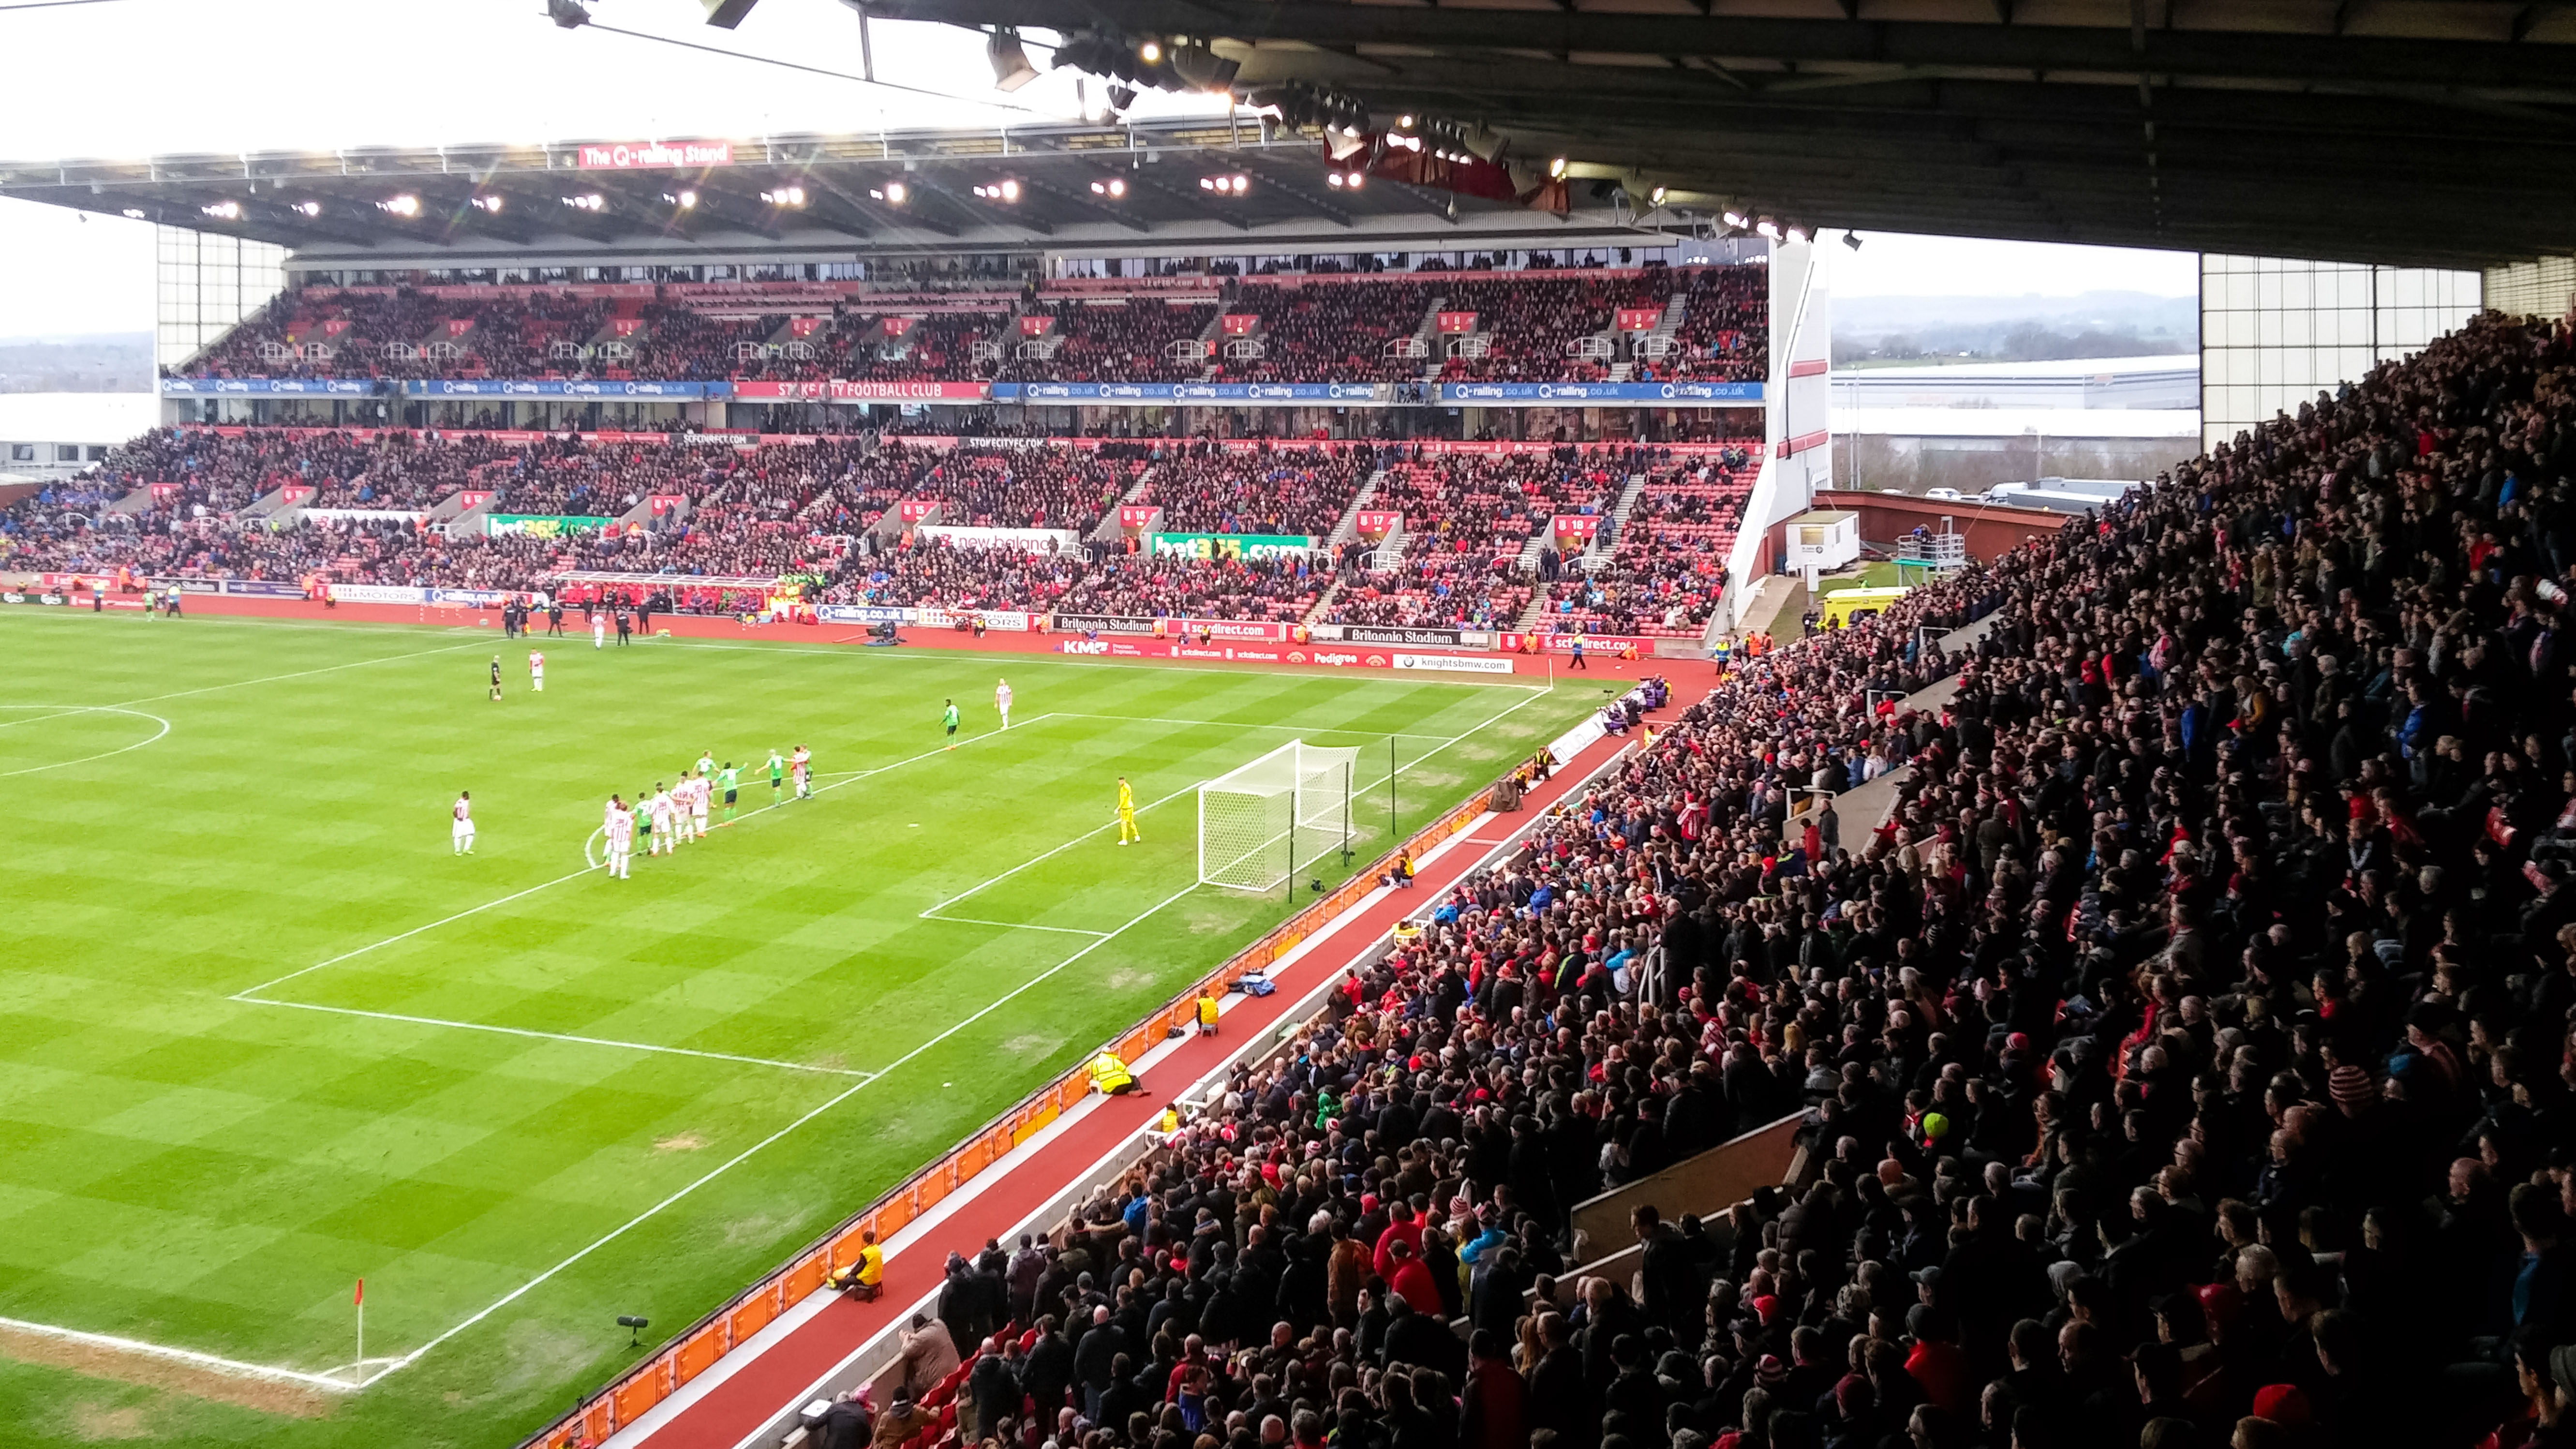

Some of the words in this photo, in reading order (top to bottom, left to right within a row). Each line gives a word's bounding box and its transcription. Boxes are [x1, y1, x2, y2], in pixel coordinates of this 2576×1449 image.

[584, 148, 610, 165] The
[685, 144, 727, 162] Stand
[1237, 317, 1243, 326] 7
[778, 384, 816, 396] STKE
[819, 384, 844, 396] CTY
[847, 384, 908, 396] FOOTBALL
[911, 384, 942, 396] CLUB
[915, 505, 924, 514] 15
[1135, 510, 1146, 519] 16
[1372, 515, 1384, 525] 17
[1572, 520, 1583, 530] 18
[959, 537, 990, 549] new
[995, 535, 1050, 550] balanc
[359, 592, 416, 600] MOTORS
[819, 606, 901, 620] Q-railing.co.uk
[1061, 617, 1107, 630] Britannia
[1109, 619, 1152, 631] Stadium
[1352, 629, 1402, 642] Britannia
[1405, 631, 1453, 644] Stadium
[1314, 653, 1357, 666] Pedigree
[1421, 657, 1505, 669] knightsbmw.com
